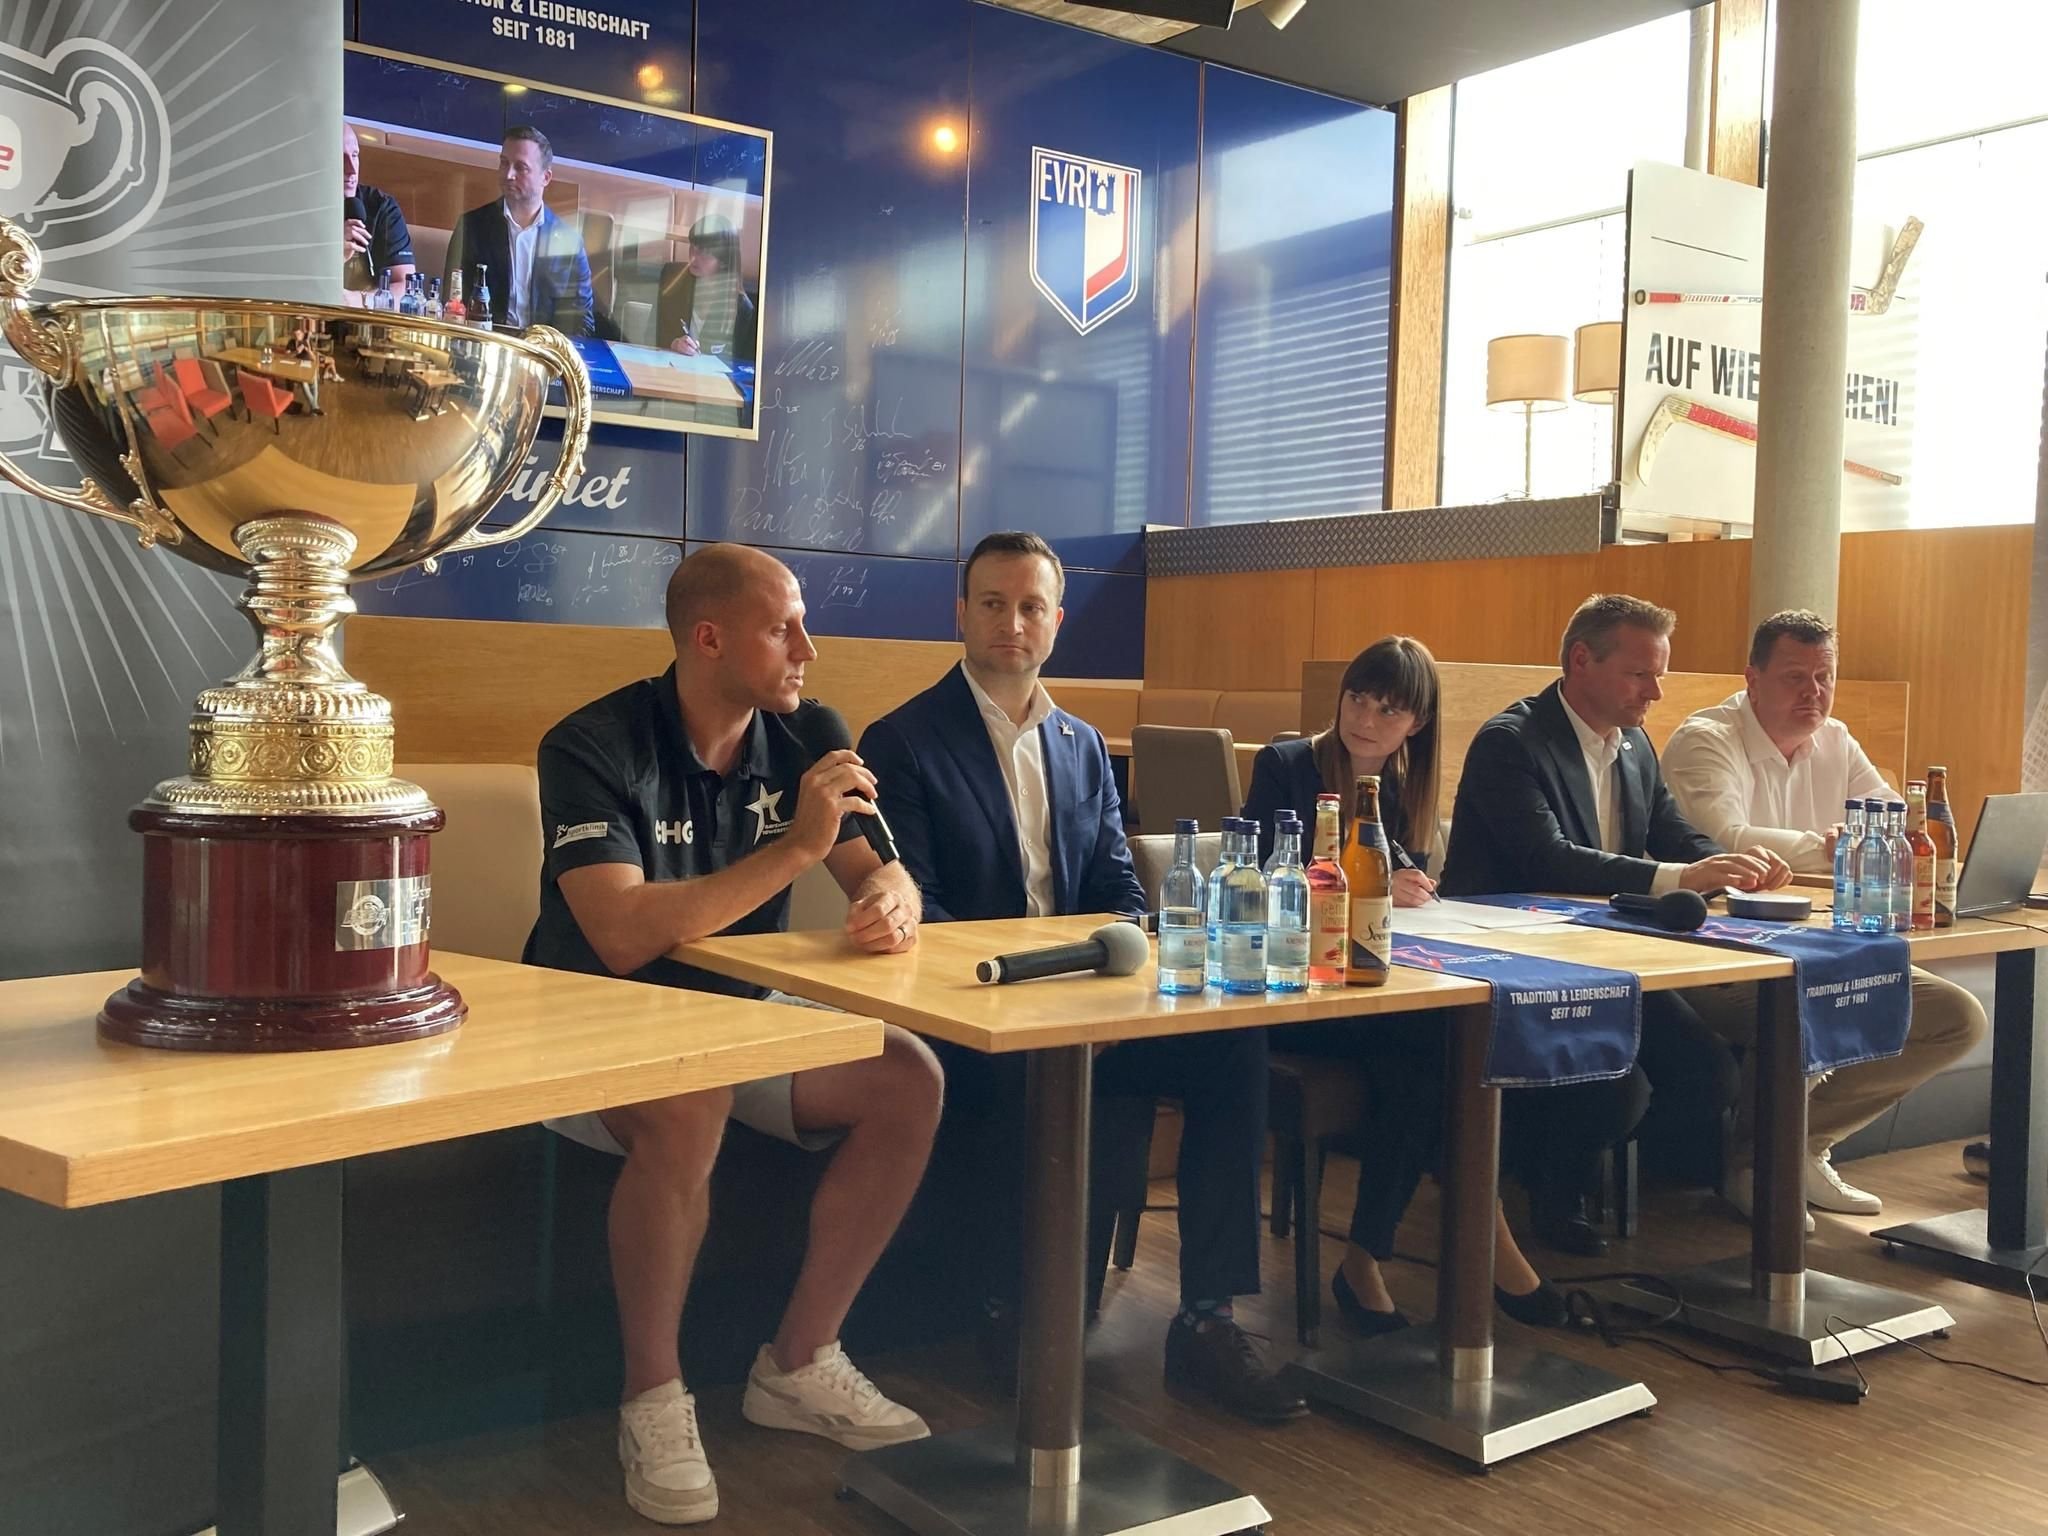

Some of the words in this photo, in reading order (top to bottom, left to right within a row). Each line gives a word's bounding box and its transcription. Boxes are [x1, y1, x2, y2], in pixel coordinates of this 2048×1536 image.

[492, 16, 530, 41] SEIT
[535, 26, 575, 50] 1881
[529, 0, 650, 40] LEIDENSCHAFT
[1040, 158, 1085, 208] EVR
[1645, 332, 1702, 390] AUF
[654, 819, 694, 845] CHG
[1510, 990, 1559, 1006] TRADITION
[1561, 990, 1568, 1002] &
[1570, 985, 1631, 1001] LEIDENSCHAFT
[1806, 981, 1844, 999] TRADITION
[1851, 972, 1903, 991] LEIDENSCHAFT
[1550, 1006, 1570, 1020] SEIT
[1571, 1006, 1592, 1018] 1881
[1834, 995, 1851, 1008] SEIT
[1852, 992, 1869, 1004] 1881
